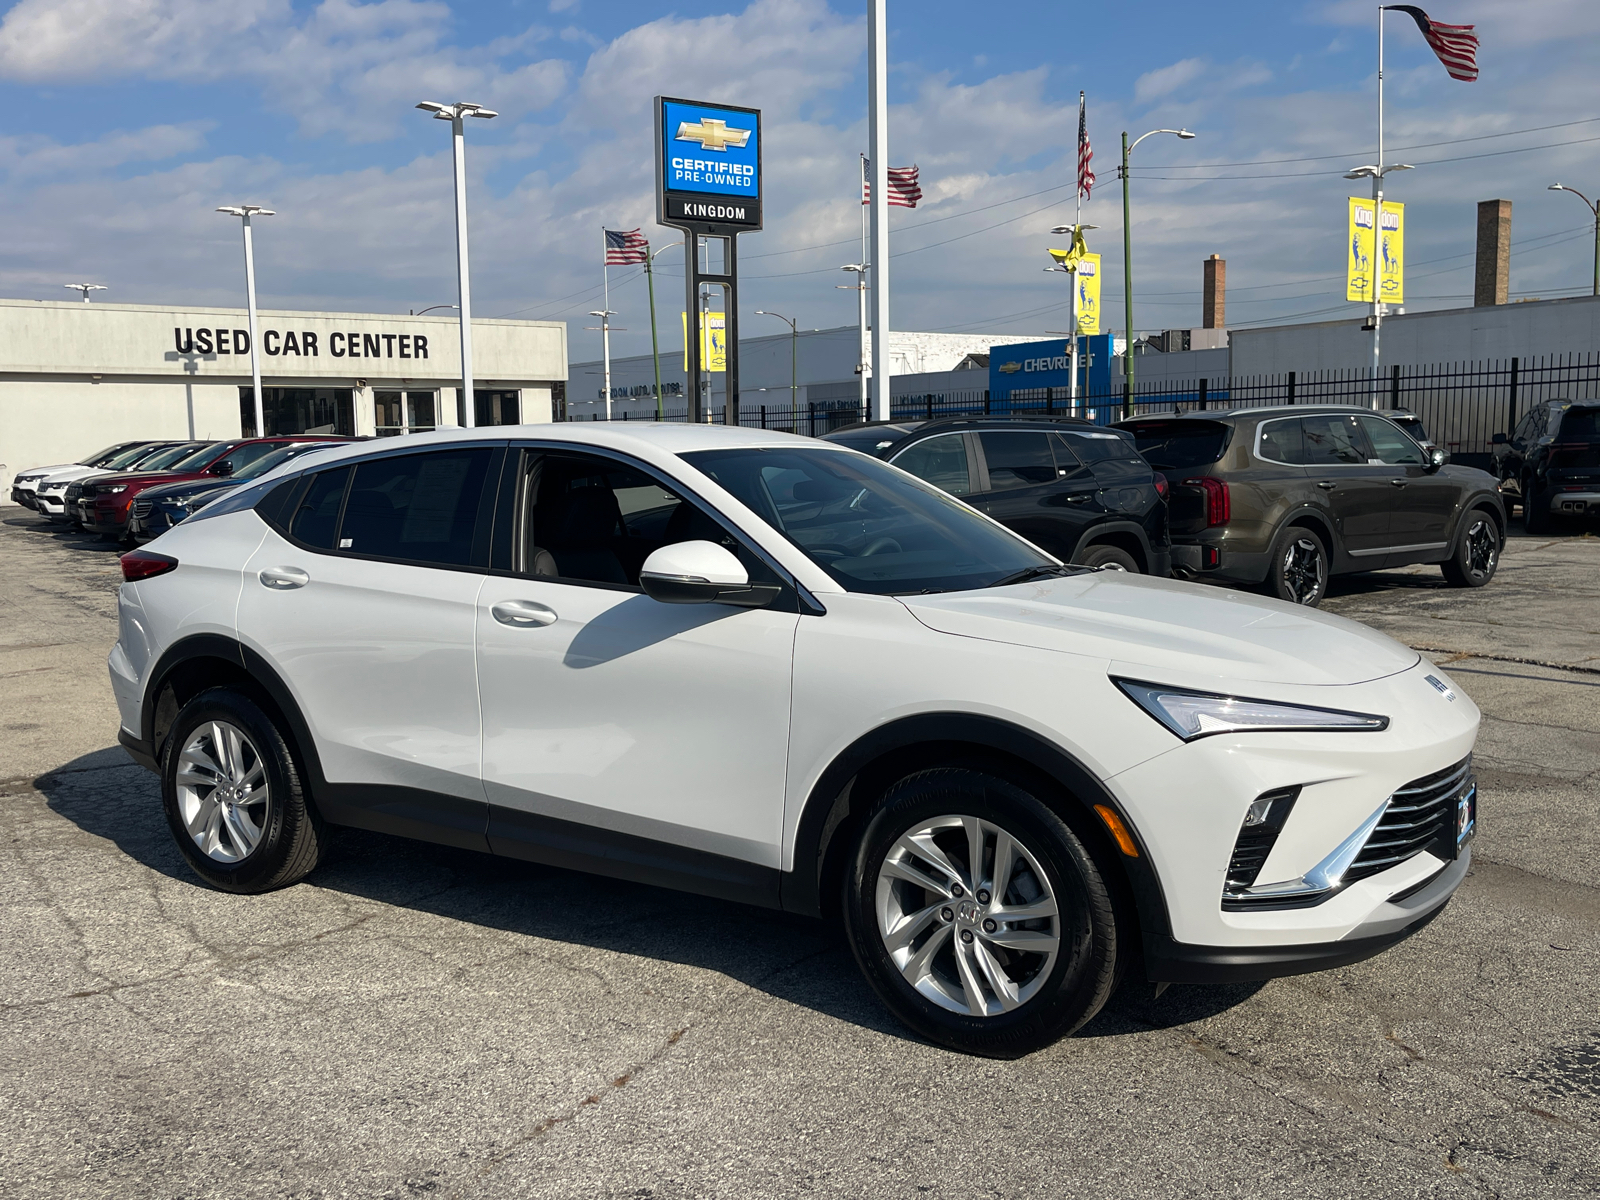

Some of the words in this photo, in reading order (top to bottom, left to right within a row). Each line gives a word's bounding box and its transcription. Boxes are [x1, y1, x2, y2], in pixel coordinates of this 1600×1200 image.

[672, 157, 754, 176] CERTIFIED
[675, 170, 751, 187] PRE-OWNED
[684, 203, 745, 219] KINGDOM
[1355, 206, 1373, 228] King
[1381, 210, 1399, 230] dom
[1079, 259, 1096, 276] dom
[174, 328, 251, 355] USED
[264, 330, 319, 356] CAR
[330, 332, 429, 359] CENTER
[1024, 353, 1095, 372] CHEVROET
